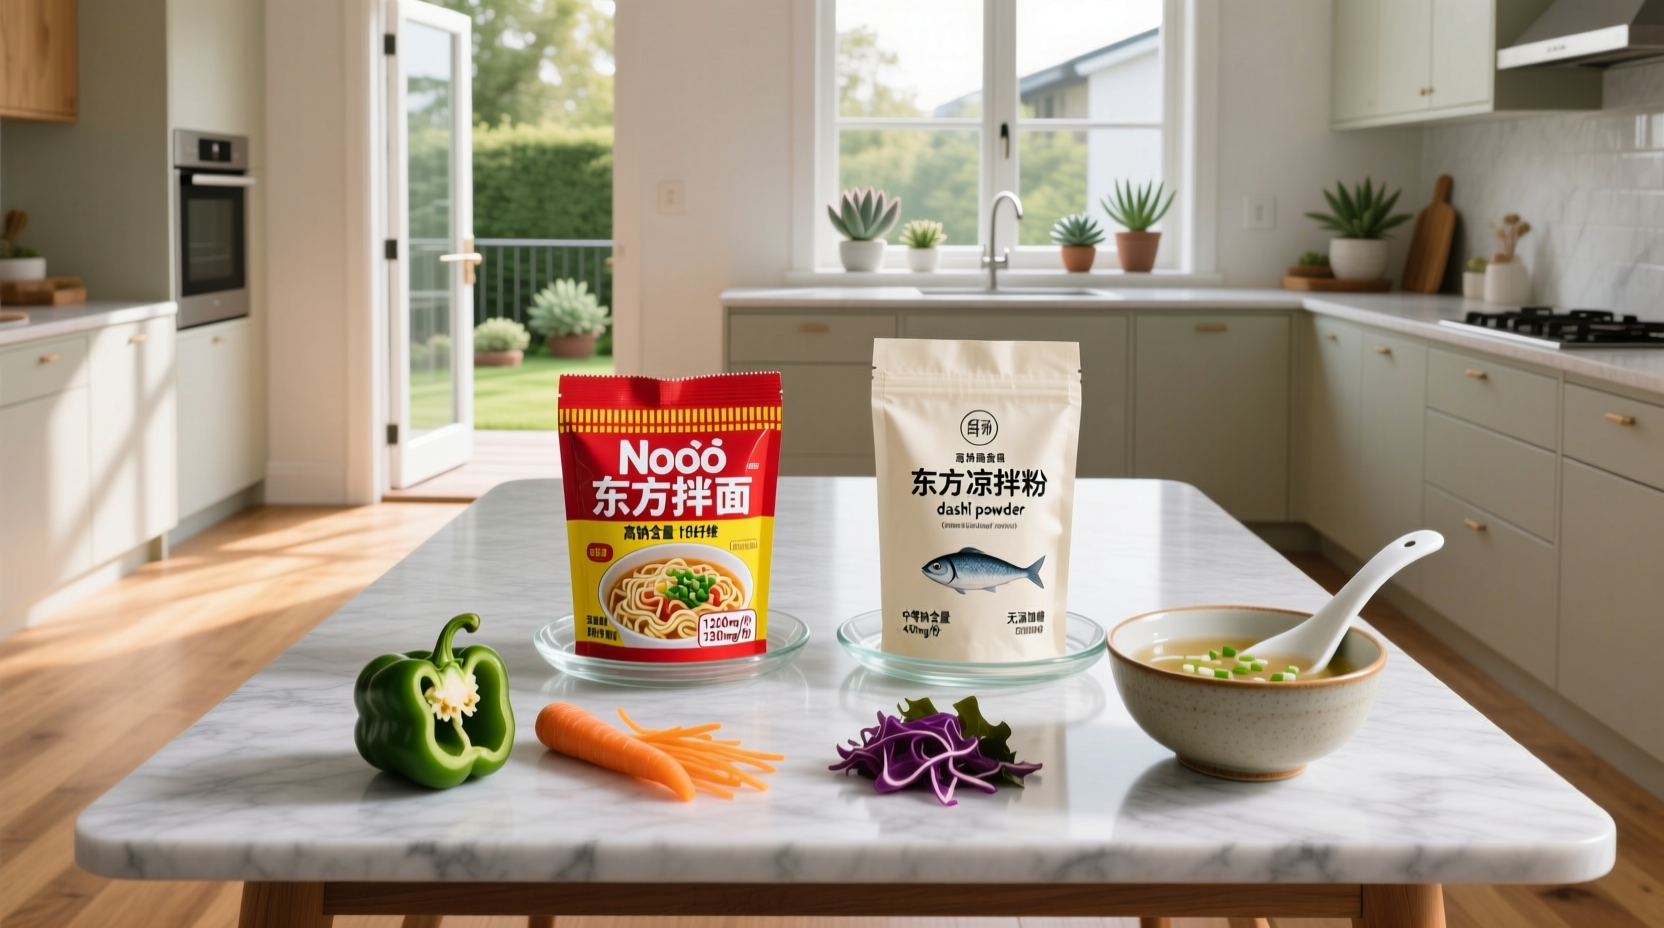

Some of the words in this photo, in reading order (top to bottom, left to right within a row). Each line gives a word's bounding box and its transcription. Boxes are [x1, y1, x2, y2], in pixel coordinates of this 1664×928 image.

[592, 475, 752, 518] 东方拌面
[911, 468, 1047, 497] 东方凉拌粉
[975, 502, 1025, 520] powder
